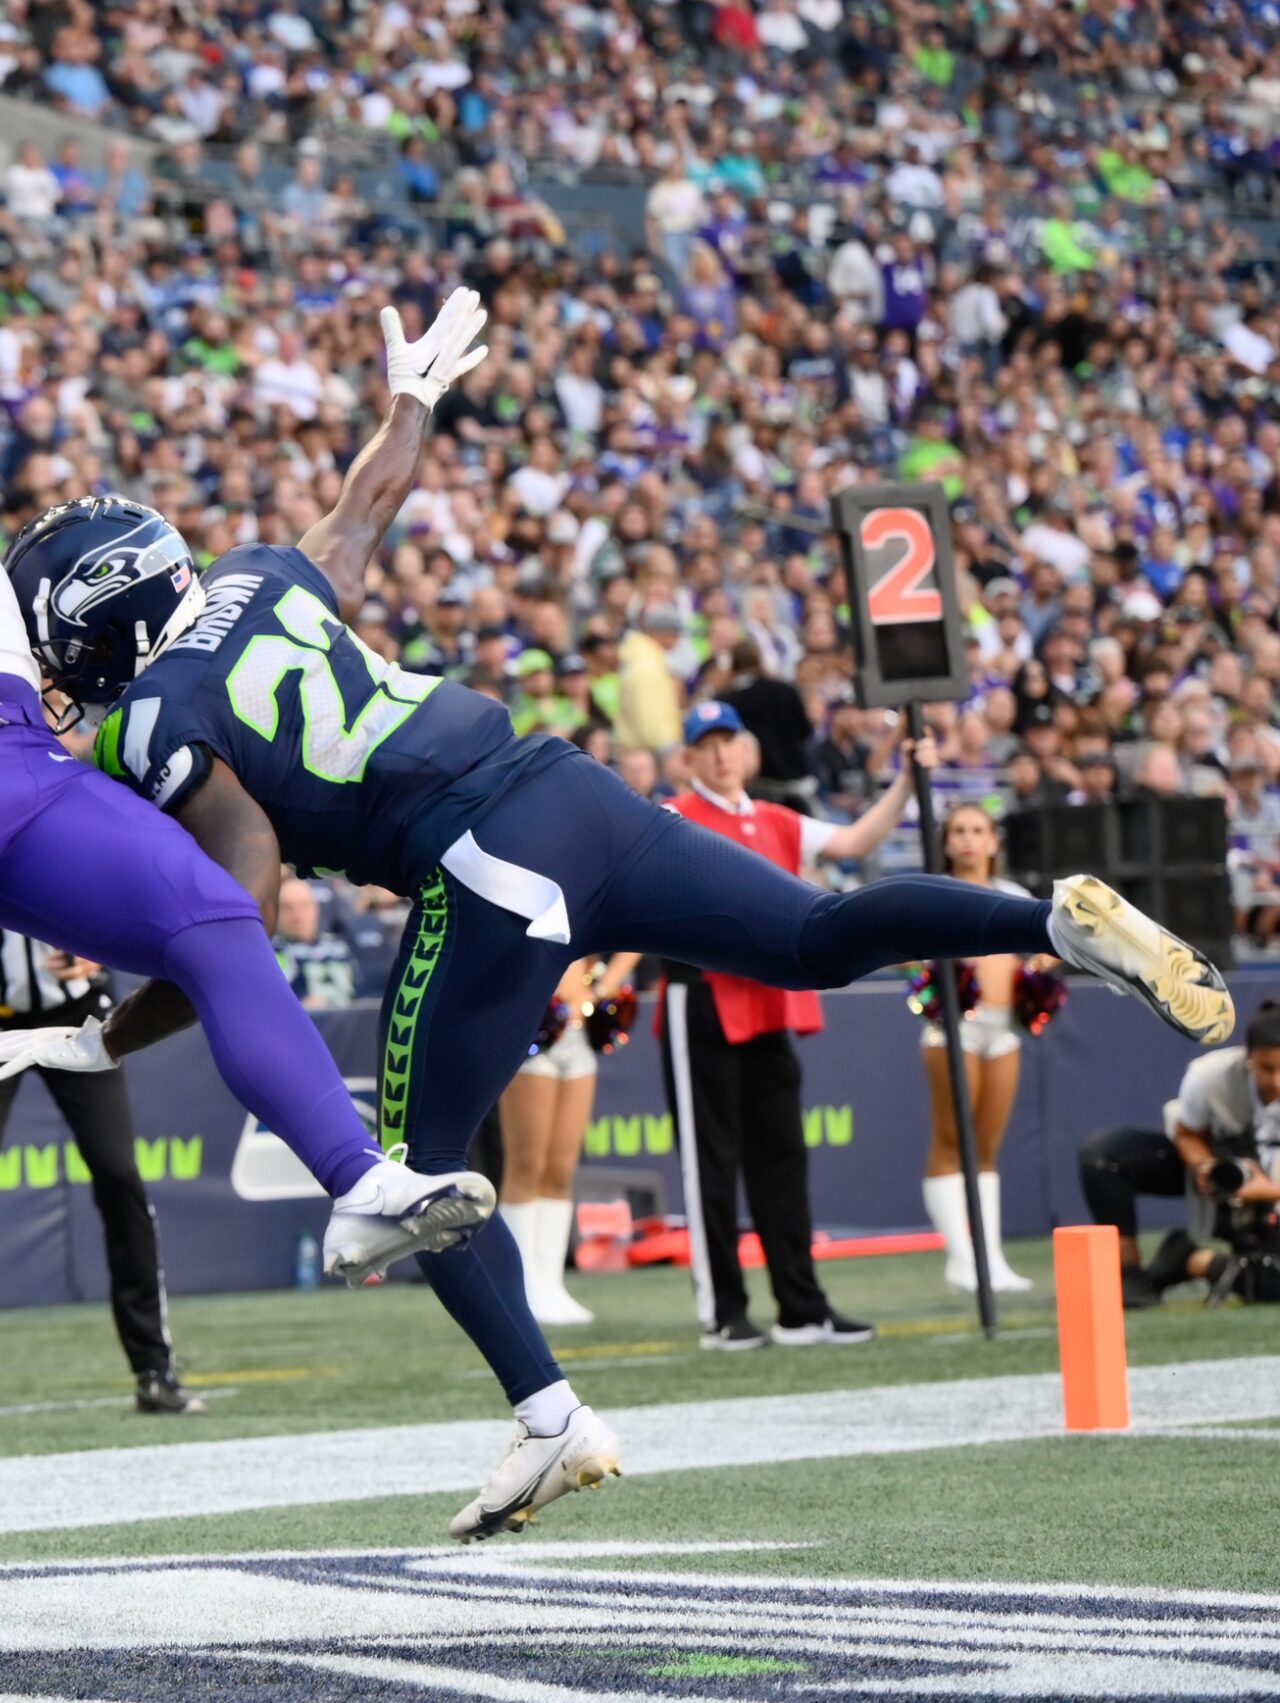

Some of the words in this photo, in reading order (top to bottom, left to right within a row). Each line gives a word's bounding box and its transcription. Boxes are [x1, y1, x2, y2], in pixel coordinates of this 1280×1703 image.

[167, 573, 264, 653] BROWN
[860, 507, 943, 625] 2
[225, 584, 445, 784] 22
